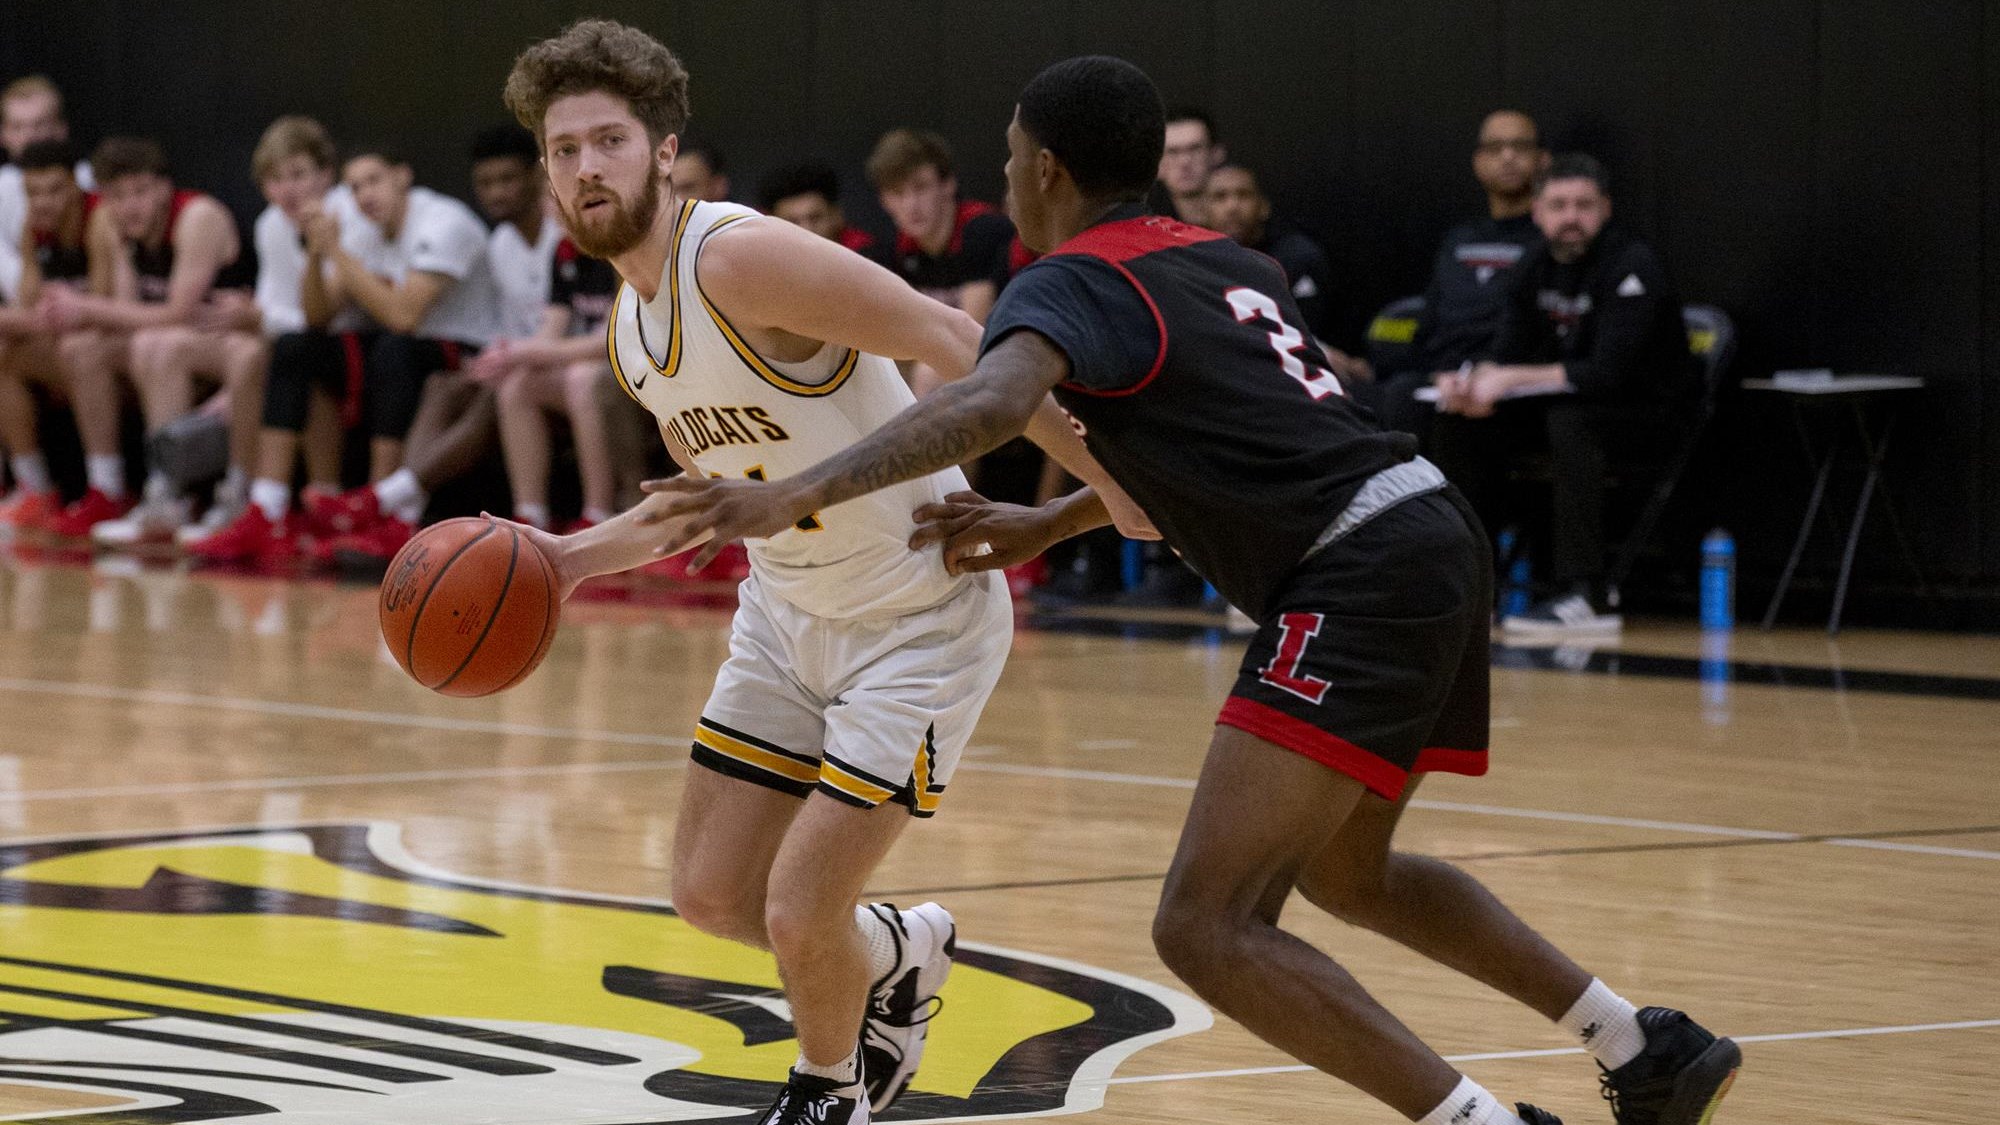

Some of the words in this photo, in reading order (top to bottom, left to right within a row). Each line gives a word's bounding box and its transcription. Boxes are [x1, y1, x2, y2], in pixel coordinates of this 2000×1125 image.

[1222, 286, 1348, 402] 2
[666, 406, 790, 458] ILDCATS
[1258, 611, 1333, 706] L
